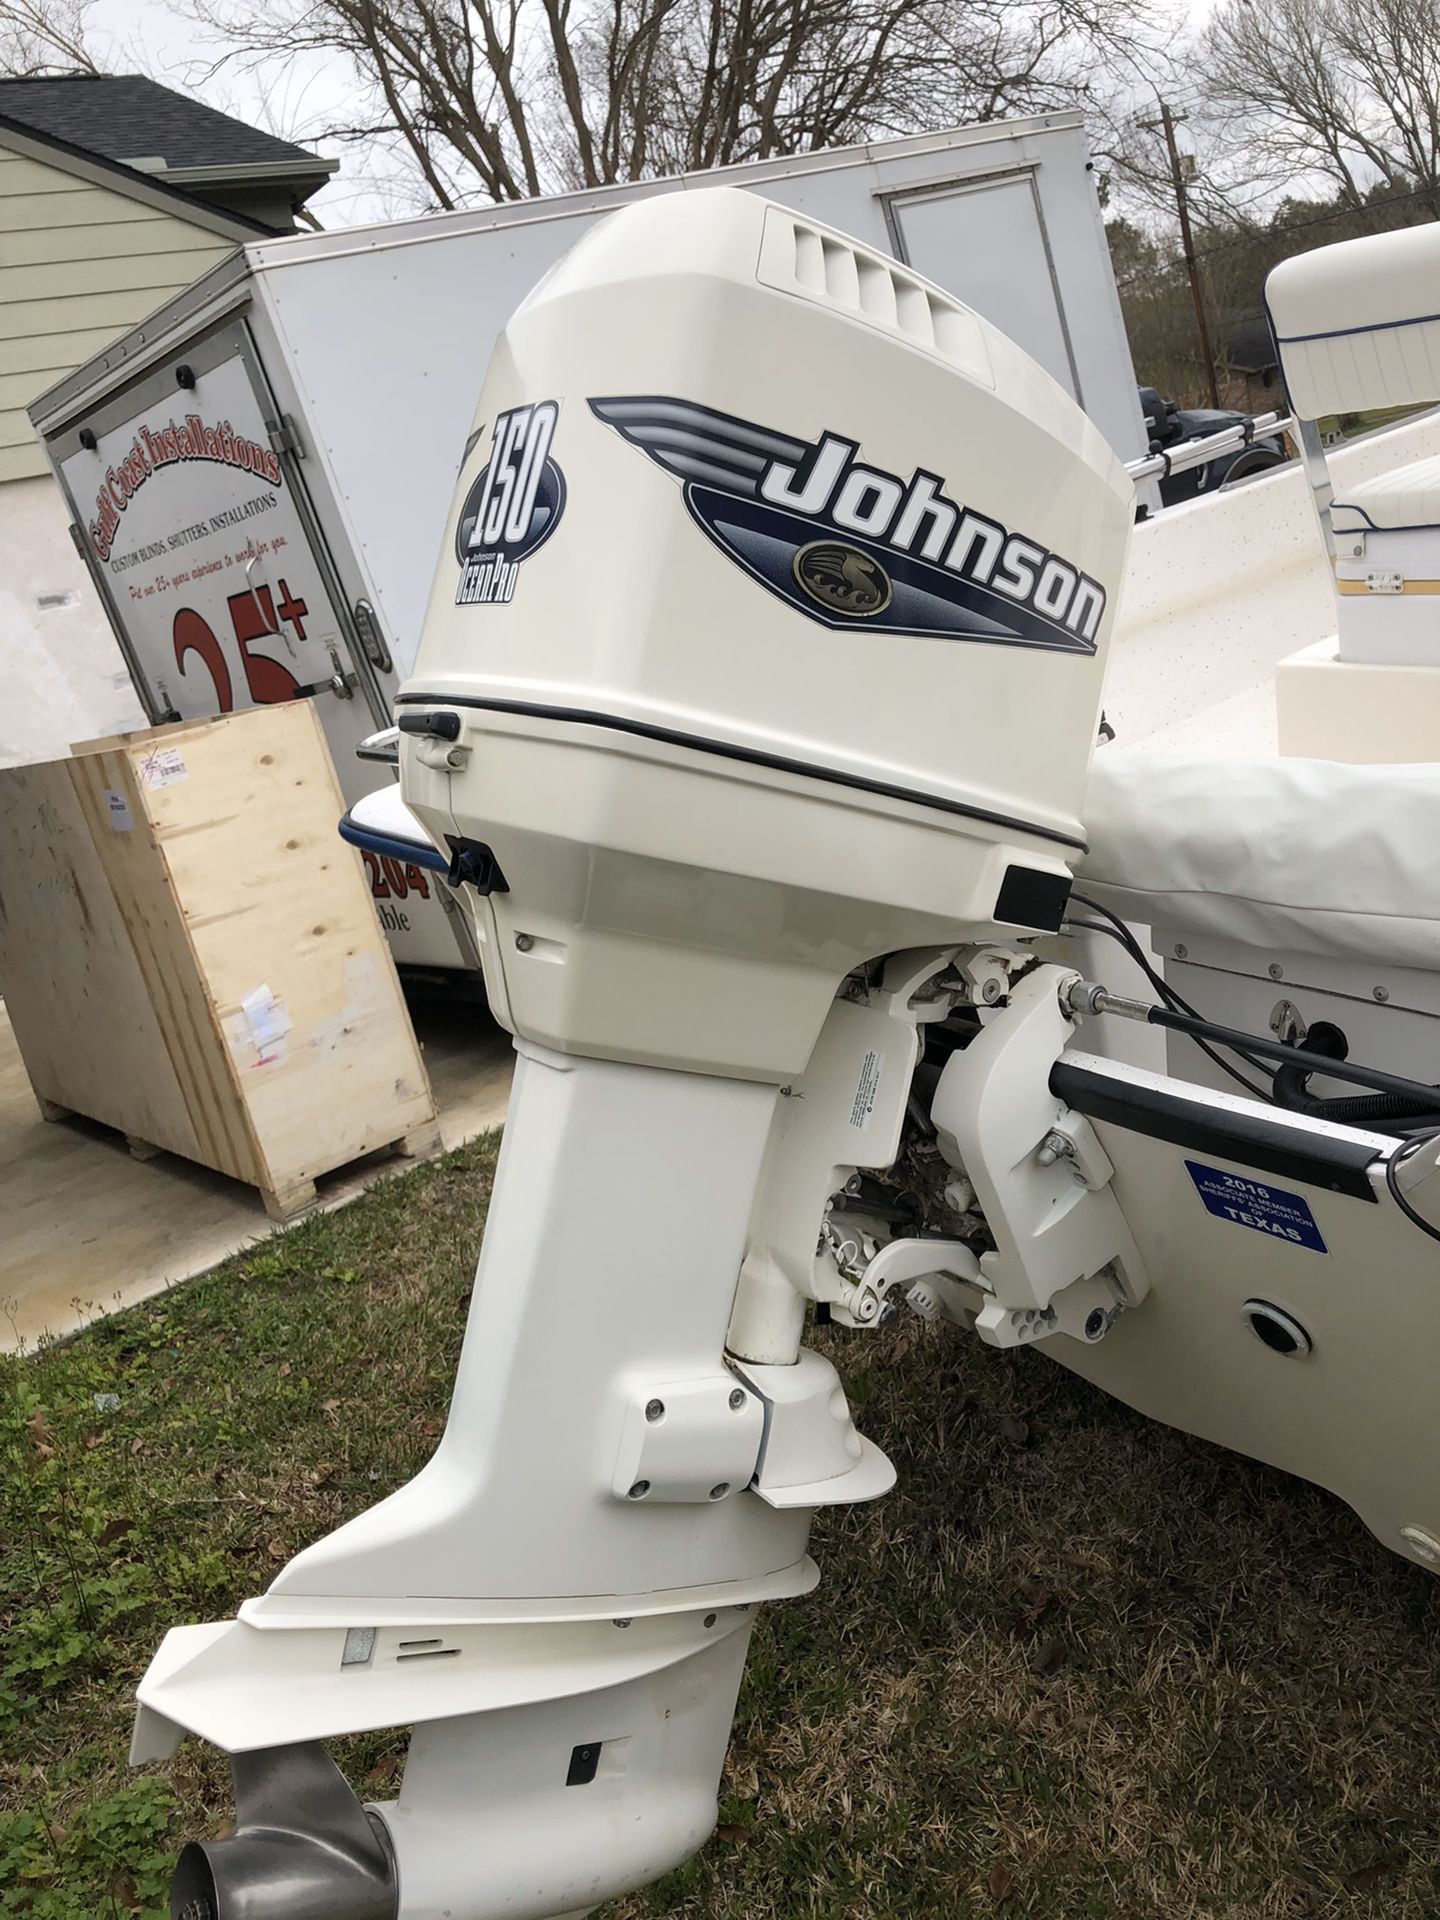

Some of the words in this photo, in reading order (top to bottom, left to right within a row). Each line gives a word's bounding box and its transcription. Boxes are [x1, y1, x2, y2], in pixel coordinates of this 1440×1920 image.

[89, 484, 120, 562] Gulf
[105, 437, 152, 511] Coast
[138, 414, 281, 487] Installations
[468, 401, 559, 548] 150
[111, 554, 142, 574] CUSTOM
[209, 492, 278, 533] INSTALLATIONS
[760, 434, 1105, 643] Johnson
[1204, 1180, 1255, 1202] ASSOCIATE
[1256, 1198, 1301, 1217] MEMBER
[1222, 1176, 1270, 1199] 2016
[1223, 1206, 1303, 1242] TEXAS
[1247, 1201, 1314, 1229] ASSOCIATION
[1250, 1207, 1264, 1218] OF
